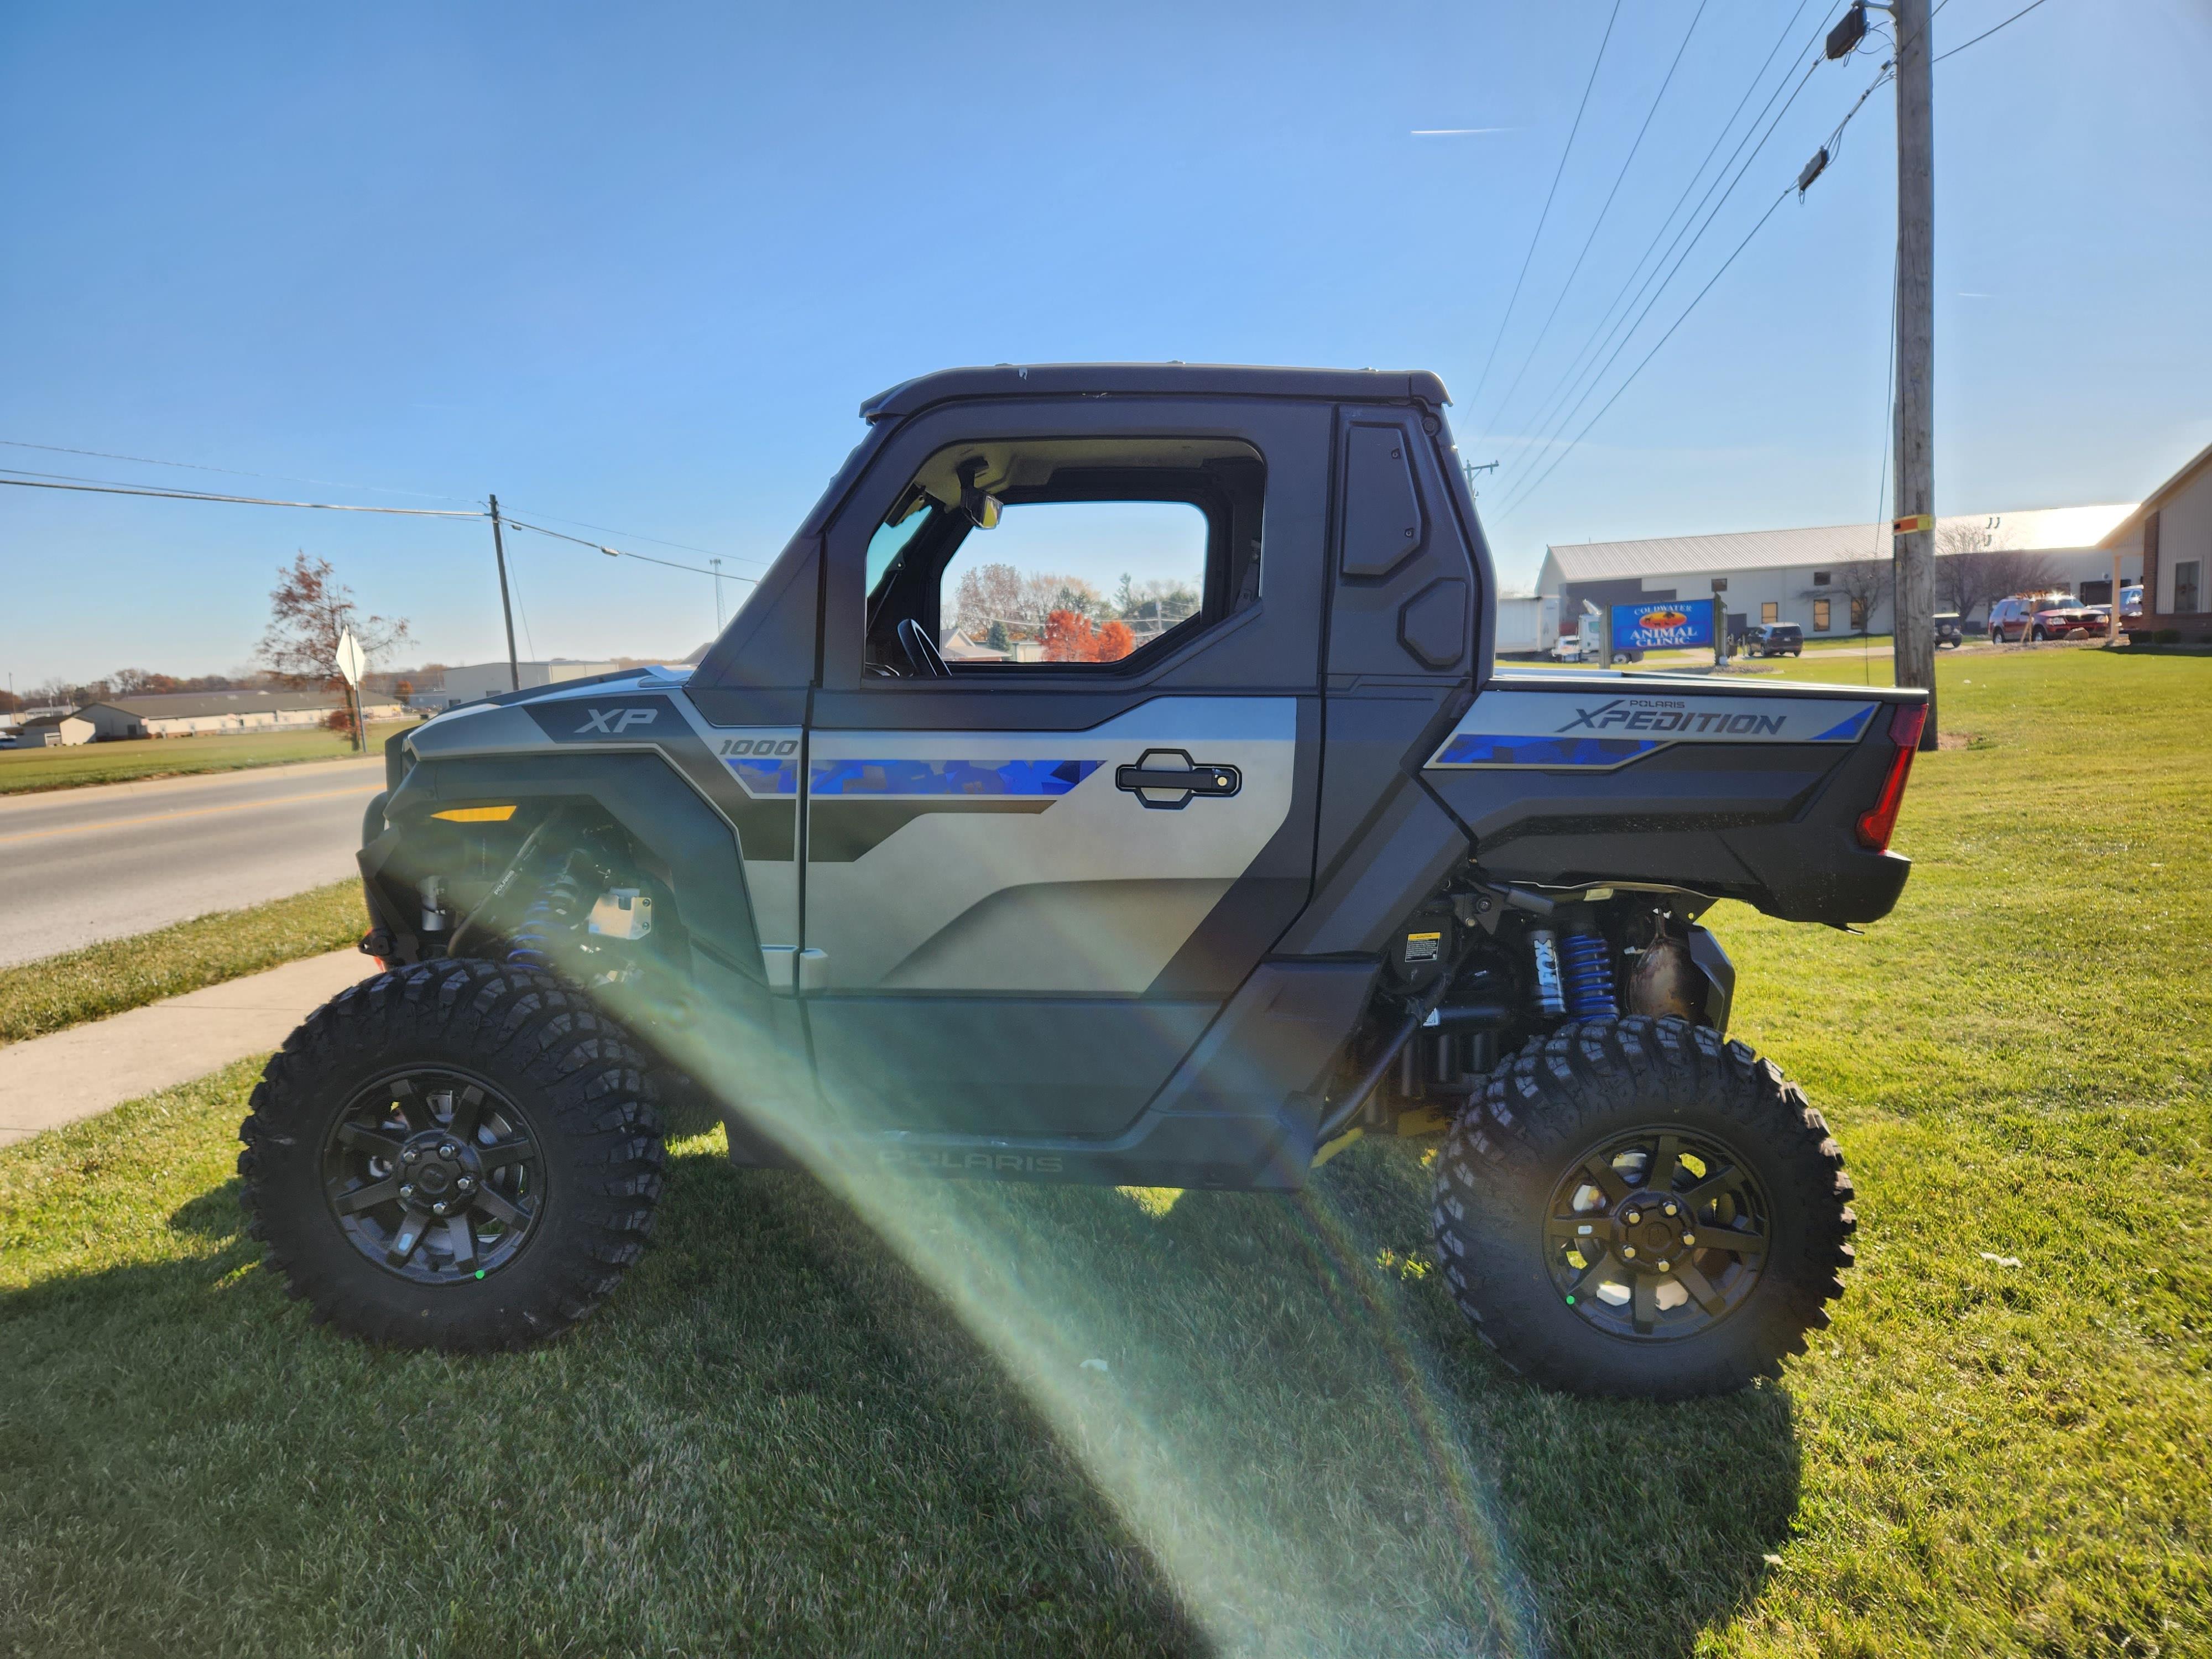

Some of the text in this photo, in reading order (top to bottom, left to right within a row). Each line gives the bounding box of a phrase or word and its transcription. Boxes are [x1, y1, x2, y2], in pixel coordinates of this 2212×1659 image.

[1634, 604, 1692, 615] COLDWATER
[1630, 627, 1698, 640] ANIMAL
[1636, 637, 1691, 647] CLINIC
[1630, 700, 1686, 708] POLARIS
[573, 708, 659, 733] XP
[1553, 700, 1787, 735] XPEDITION
[719, 739, 800, 756] 1000
